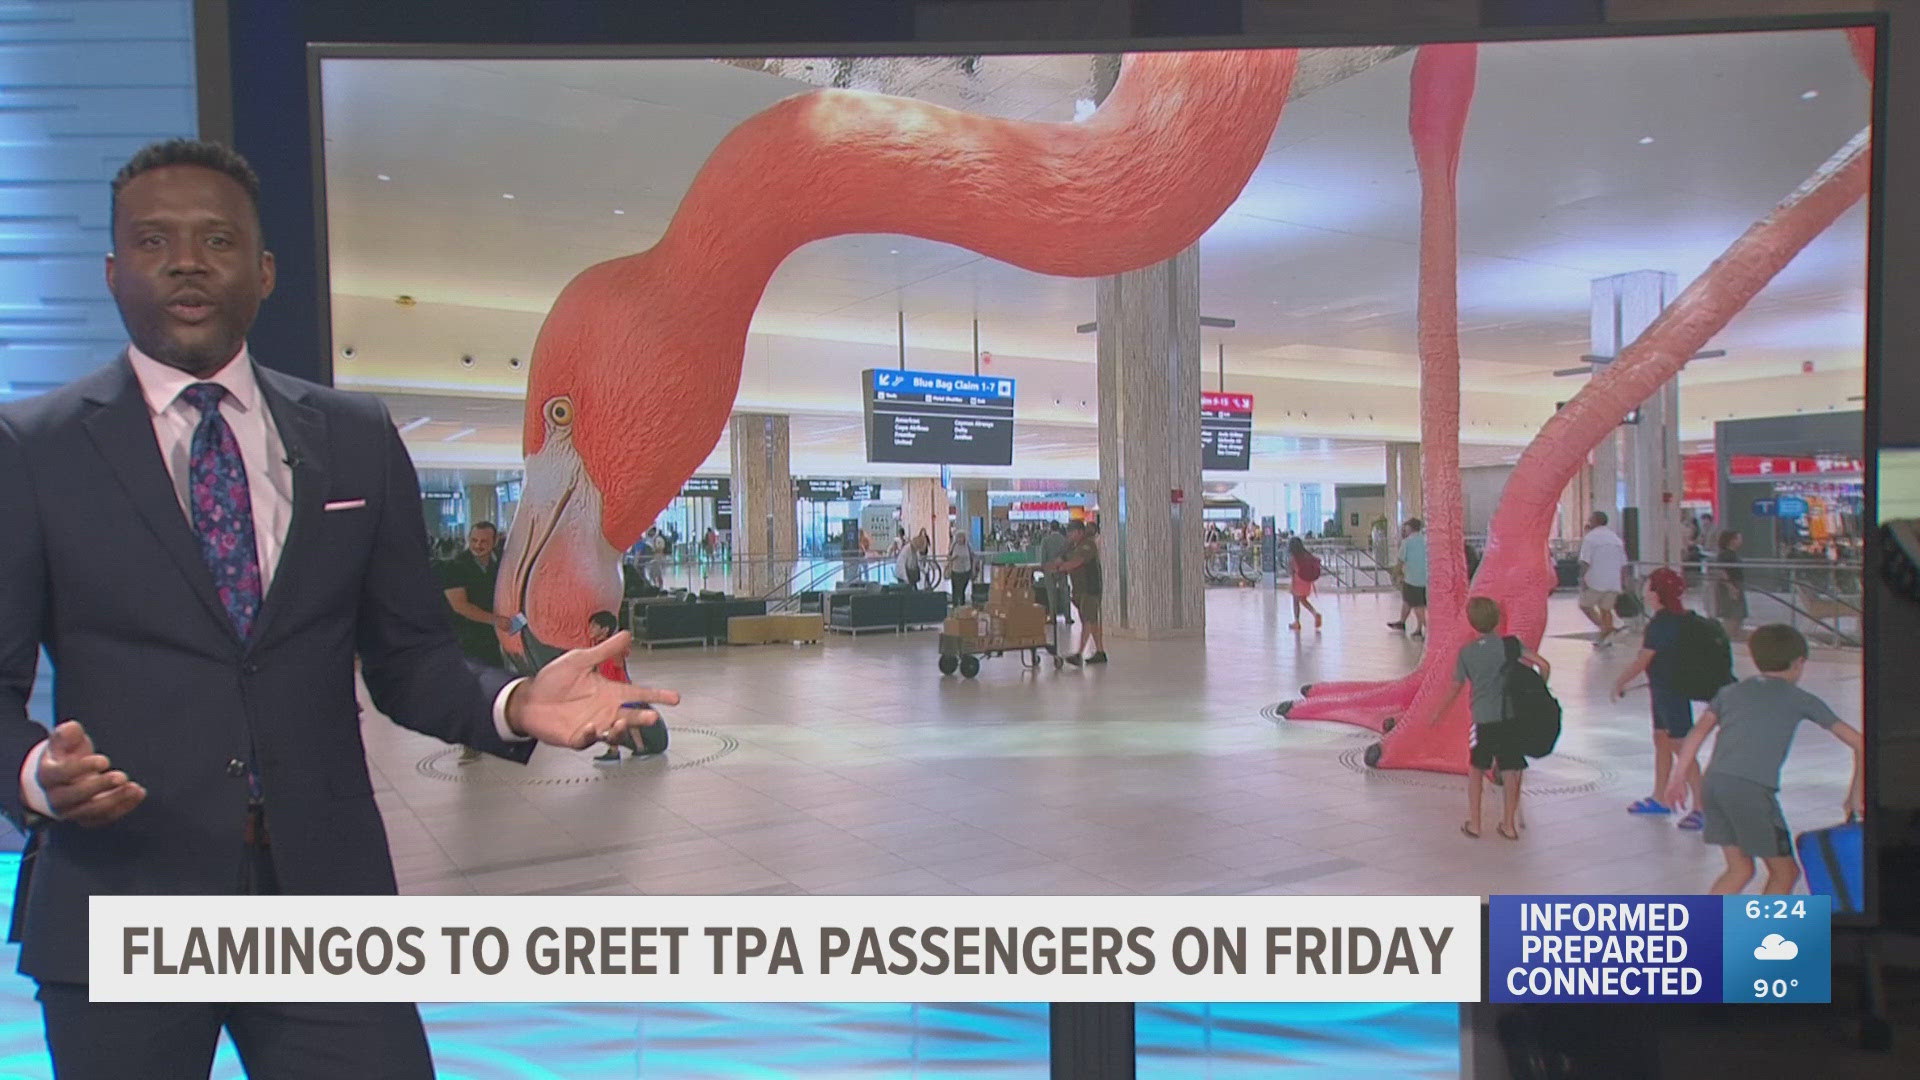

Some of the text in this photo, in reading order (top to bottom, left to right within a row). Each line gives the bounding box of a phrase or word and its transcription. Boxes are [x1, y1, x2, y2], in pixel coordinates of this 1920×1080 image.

[913, 377, 995, 392] Blue Bag Claim 1-7
[895, 424, 908, 432] Copa
